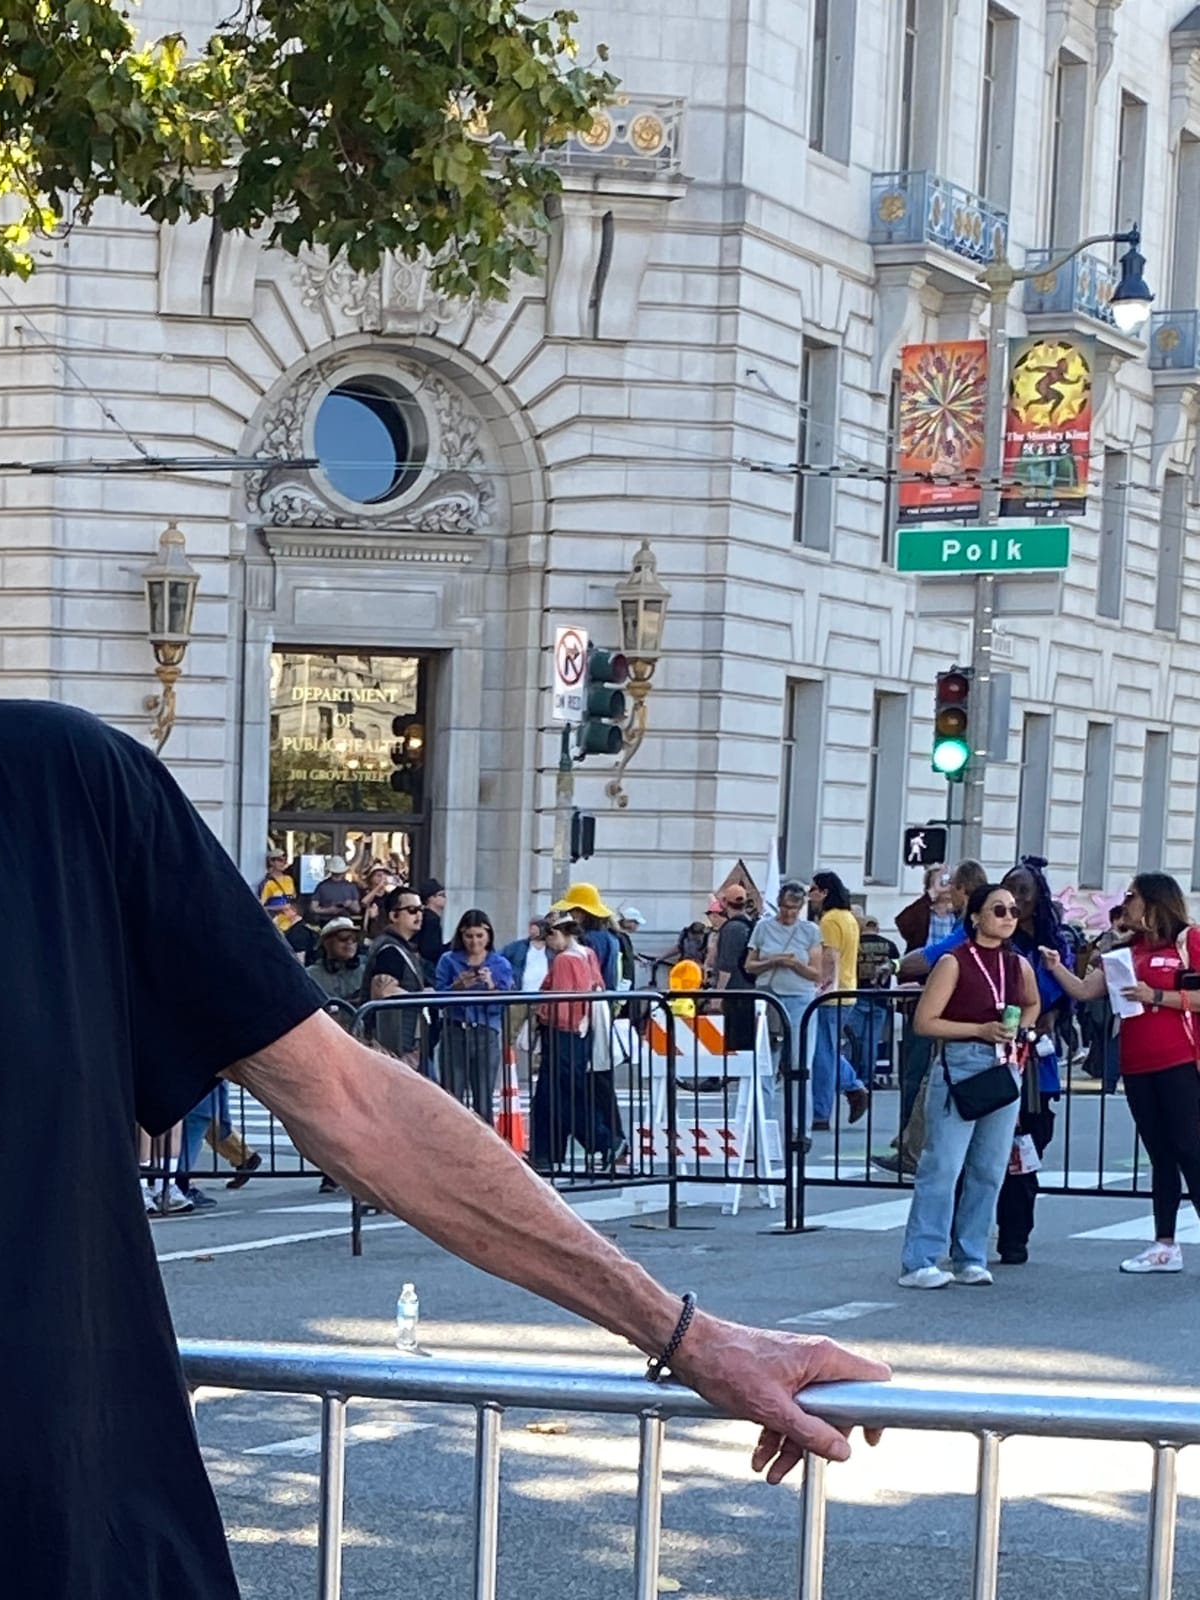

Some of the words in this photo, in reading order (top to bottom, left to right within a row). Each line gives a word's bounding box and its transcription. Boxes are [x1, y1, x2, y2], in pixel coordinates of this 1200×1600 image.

[942, 539, 1022, 562] Polk
[292, 687, 399, 703] DEPARTMENT
[333, 713, 354, 728] OF
[282, 736, 336, 752] PUBLIC
